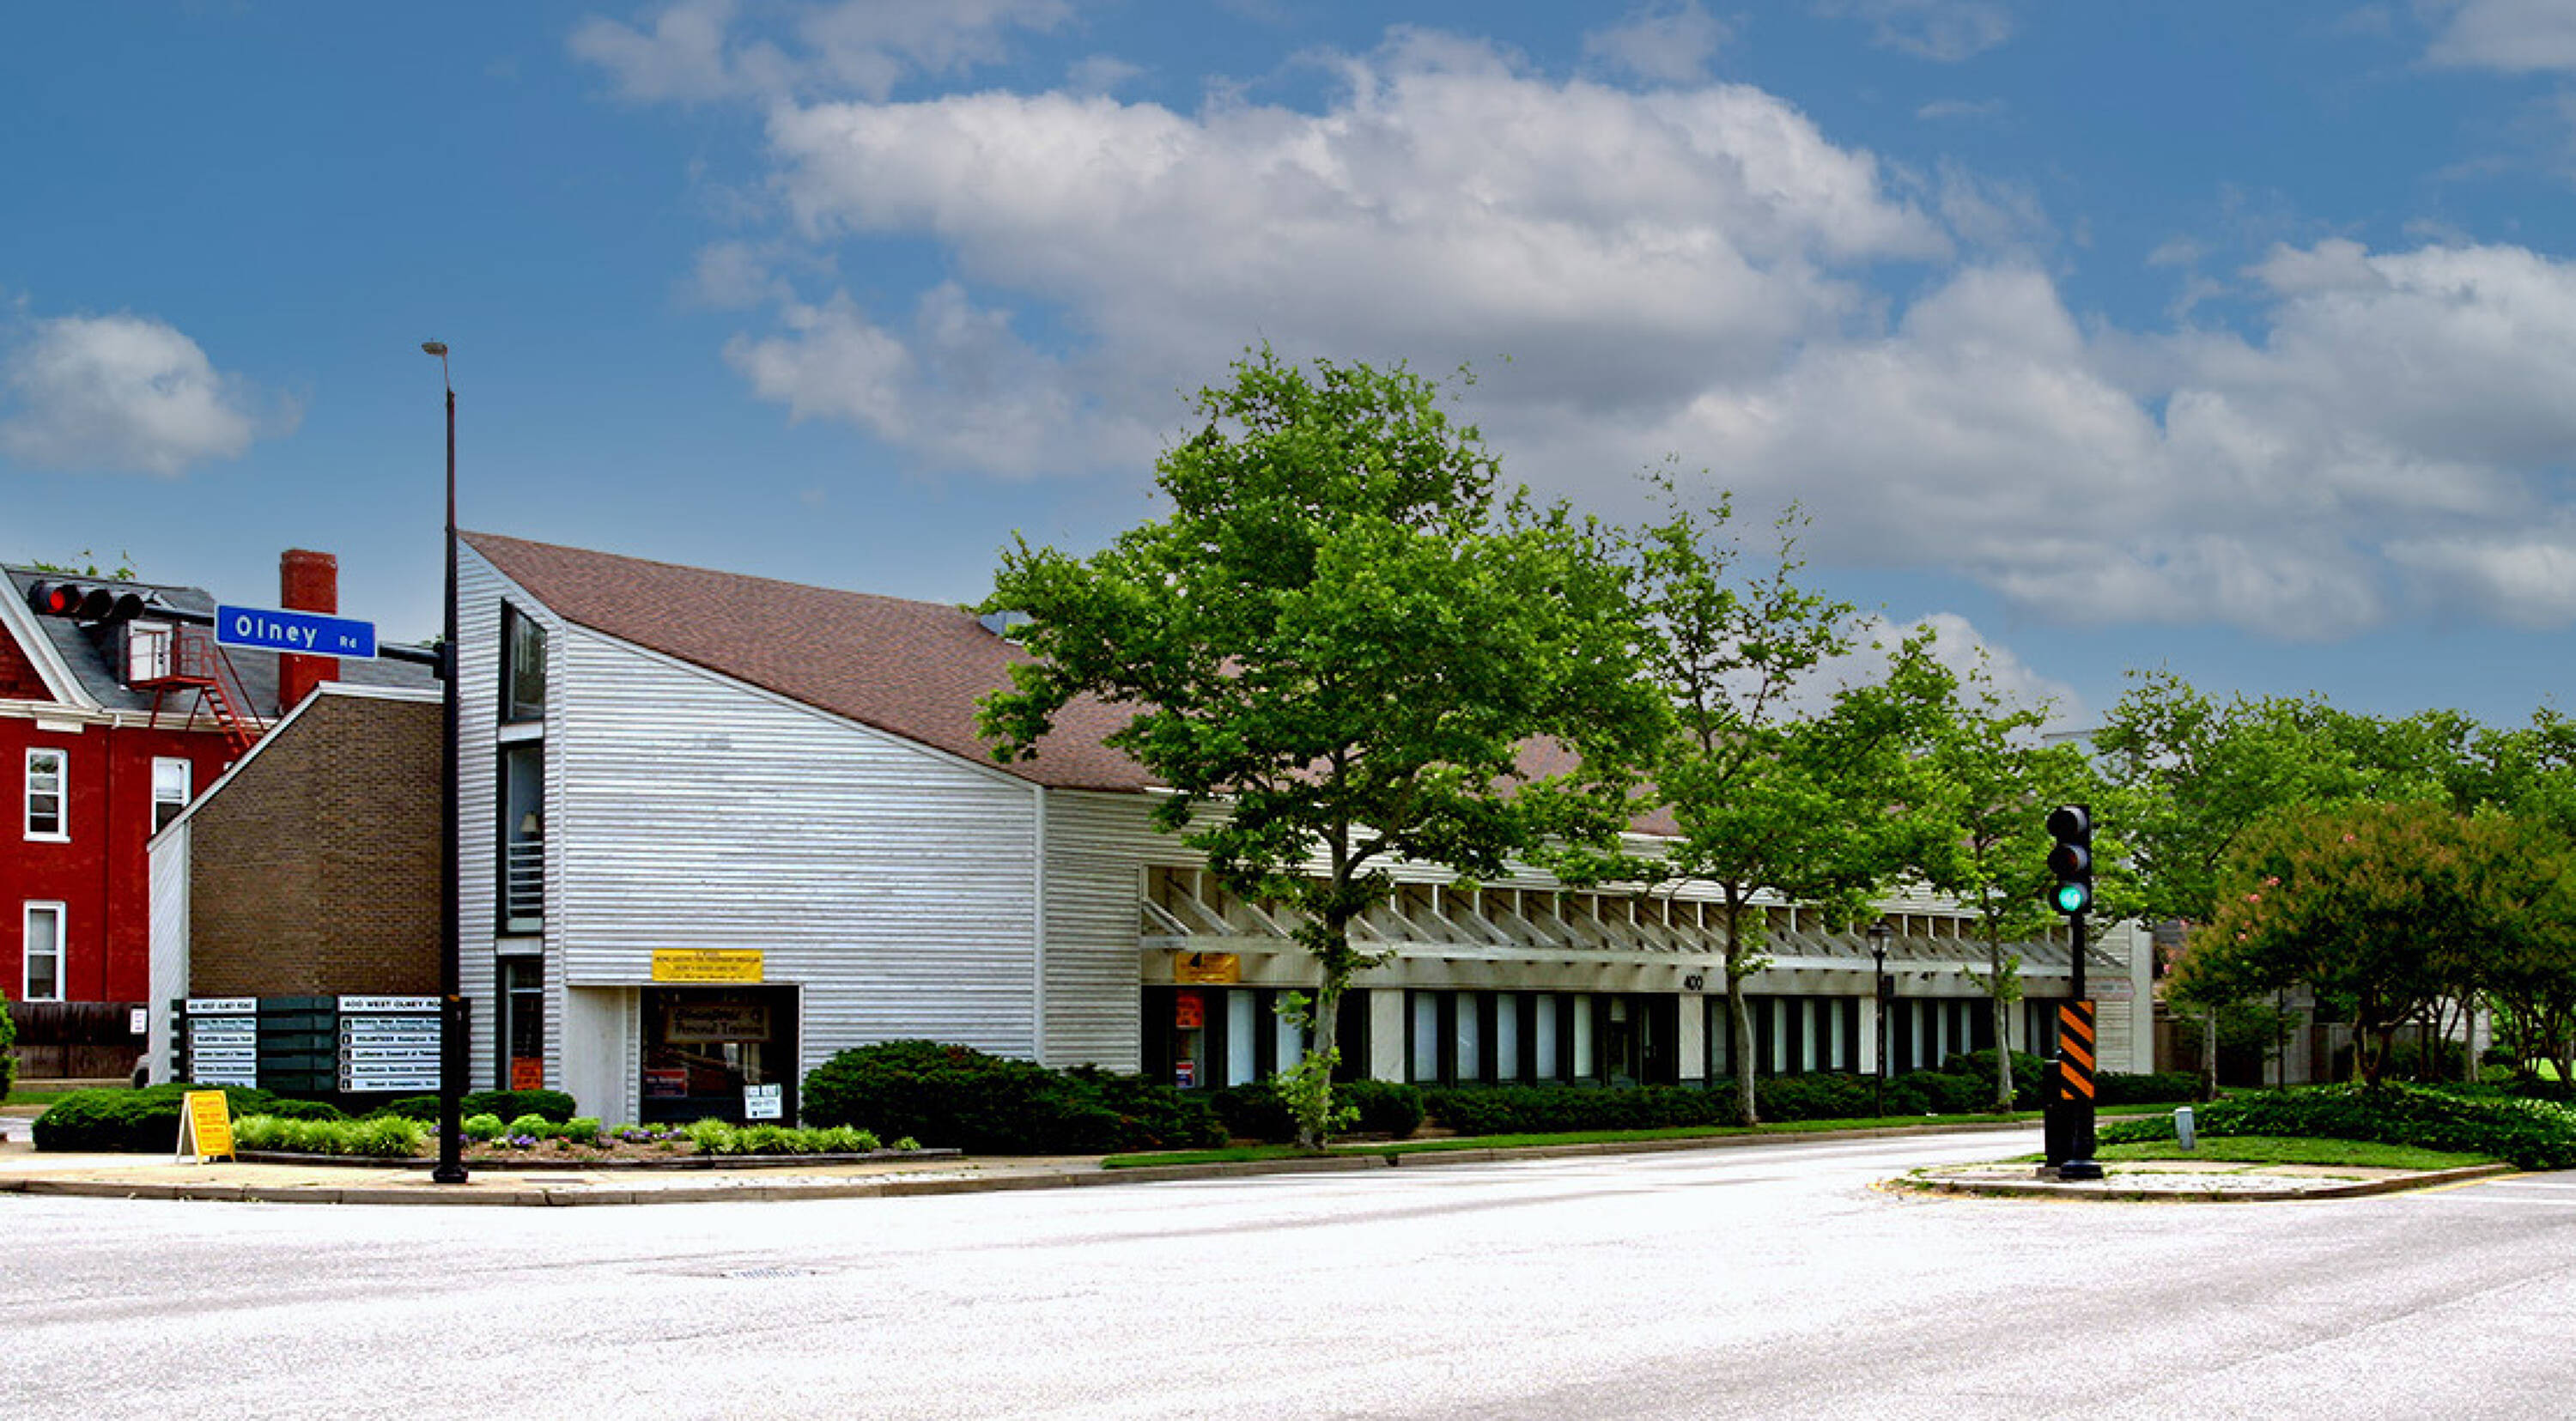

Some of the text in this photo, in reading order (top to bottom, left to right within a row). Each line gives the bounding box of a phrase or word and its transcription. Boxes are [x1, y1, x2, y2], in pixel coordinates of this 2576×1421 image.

[234, 614, 358, 649] Olney Rd
[1684, 975, 1704, 991] 400
[343, 999, 364, 1009] 400
[393, 999, 423, 1009] OLNEY
